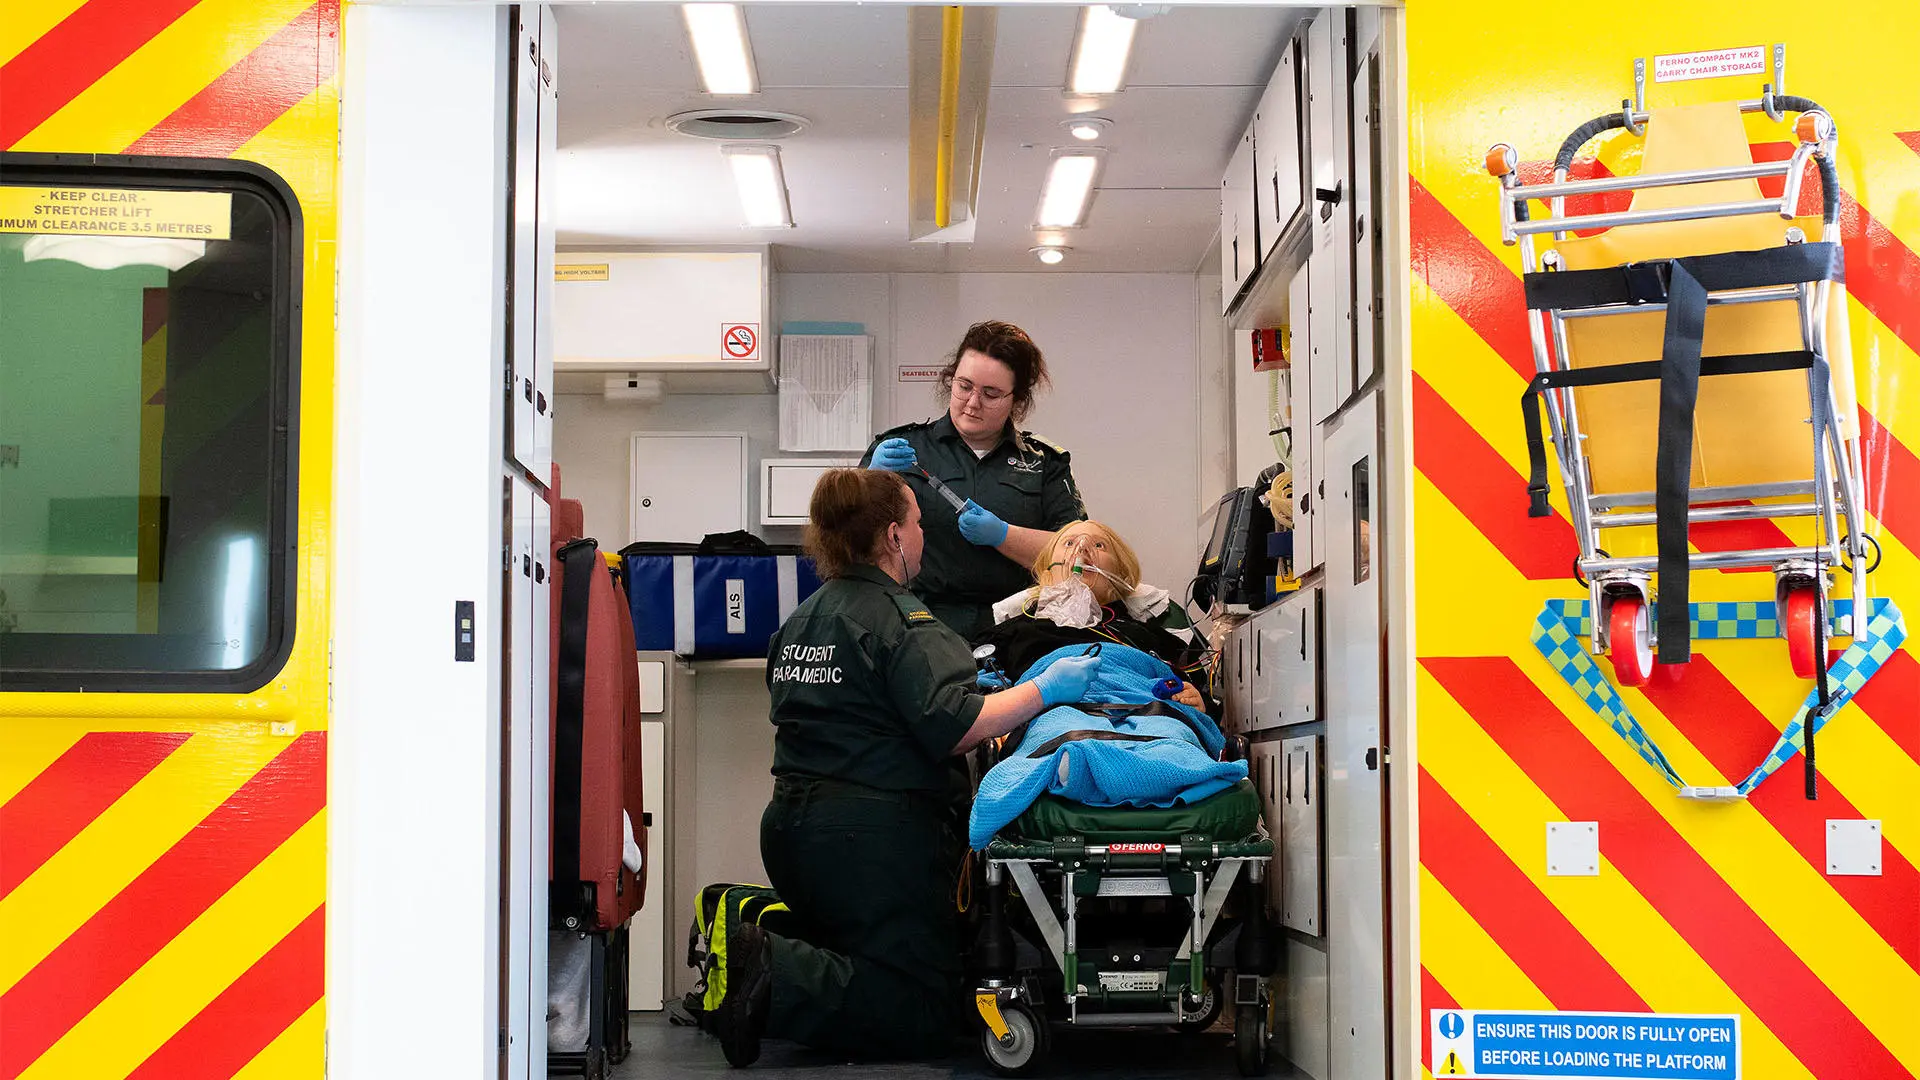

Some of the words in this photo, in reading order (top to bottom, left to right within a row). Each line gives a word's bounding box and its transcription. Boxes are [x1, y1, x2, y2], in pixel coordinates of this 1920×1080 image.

[1660, 57, 1690, 66] FERNO
[1693, 53, 1736, 64] COMPACT
[1739, 50, 1760, 60] MK2
[1656, 69, 1688, 78] CARRY
[1689, 65, 1718, 75] CHAIR
[1720, 61, 1764, 73] STORAGE
[50, 190, 87, 201] KEEP
[91, 192, 138, 203] CLEAR
[34, 204, 118, 217] STRETCHER
[122, 206, 152, 218] LIFT
[42, 219, 127, 232] CLEARANCE
[131, 222, 152, 233] 3.5
[156, 222, 213, 234] METRES
[729, 592, 741, 620] ALS
[781, 644, 836, 663] STUDENT
[772, 665, 843, 684] PARAMEDIC
[1122, 843, 1162, 851] FERNO
[1477, 1023, 1536, 1039] ENSURE
[1539, 1024, 1573, 1040] THIS
[1575, 1024, 1619, 1041] DOOR
[1622, 1025, 1636, 1041] IS
[1640, 1026, 1685, 1042] FULLY
[1688, 1027, 1731, 1043] OPEN
[1482, 1050, 1541, 1066] BEFORE
[1544, 1051, 1610, 1068] LOADING
[1613, 1053, 1642, 1069] THE
[1646, 1054, 1726, 1071] PLATFORM
